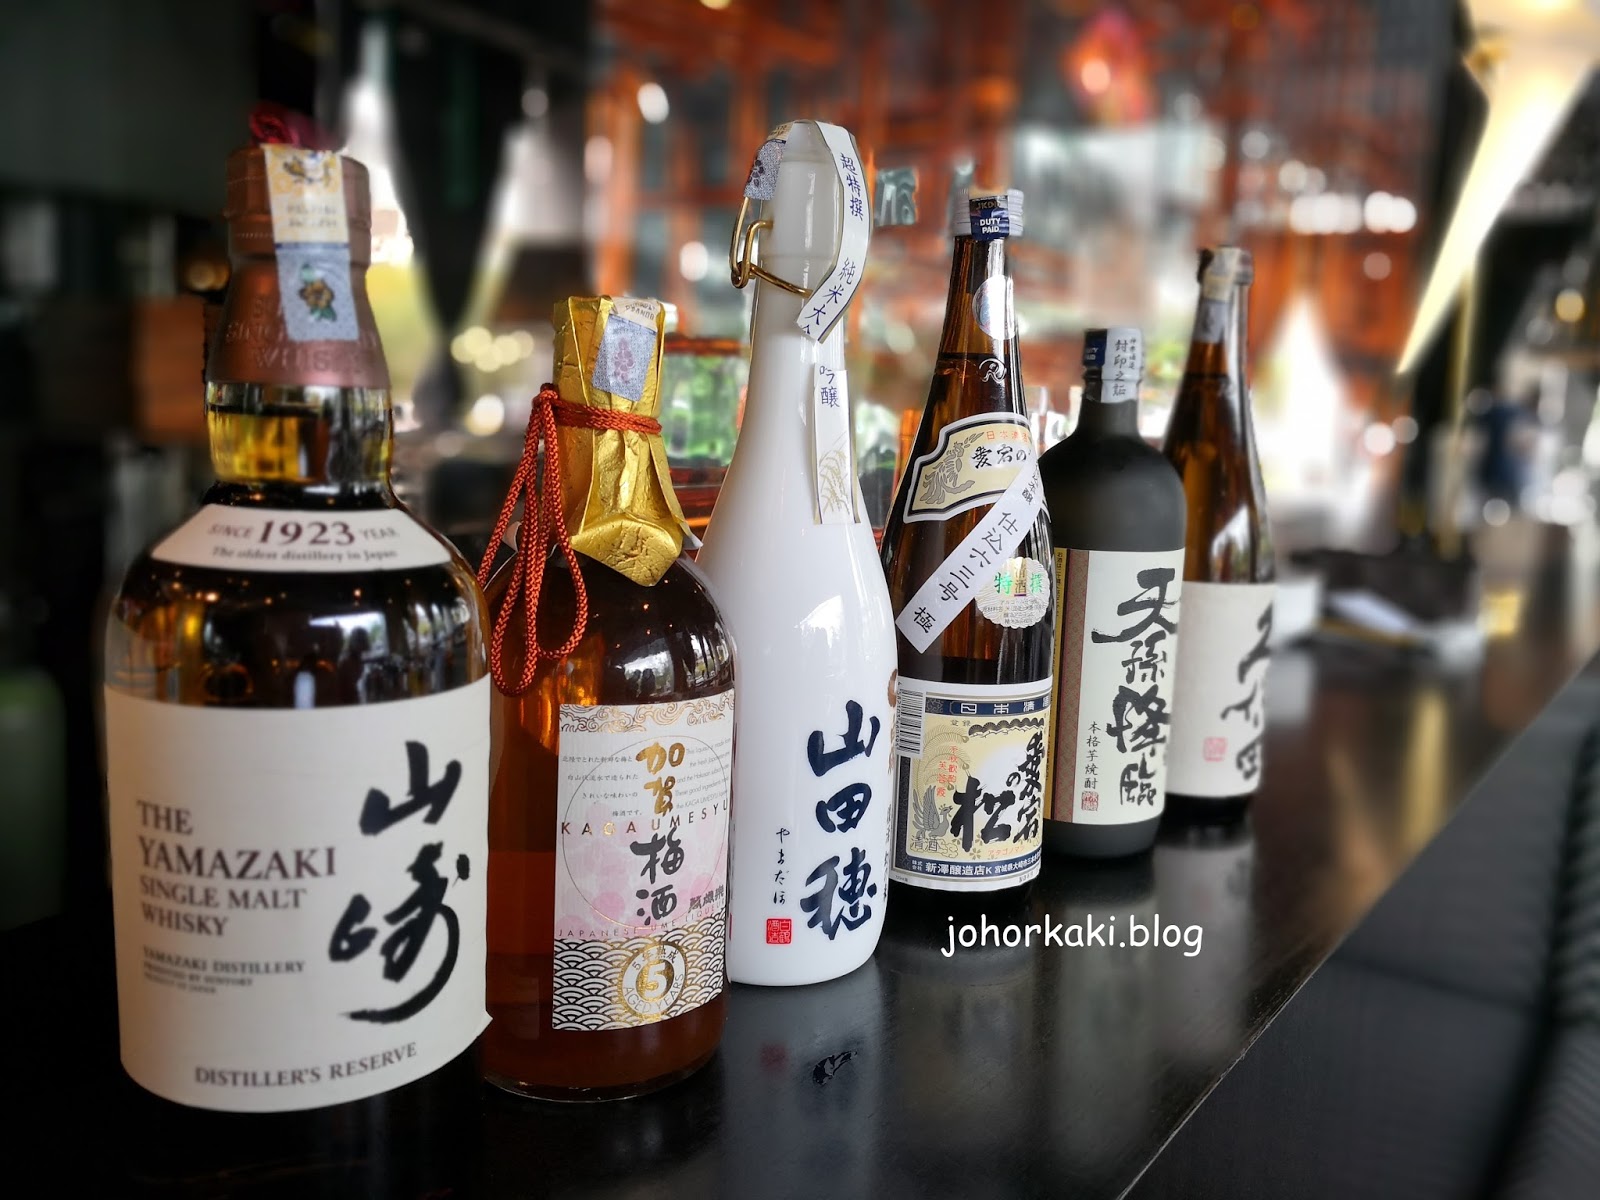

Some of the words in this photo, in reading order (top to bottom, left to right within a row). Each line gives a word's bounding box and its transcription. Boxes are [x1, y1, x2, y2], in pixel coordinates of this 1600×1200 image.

[979, 217, 1001, 227] DUTY
[981, 225, 1000, 235] PAID
[971, 444, 1032, 469] 愛宕の
[206, 523, 255, 539] SINCE
[258, 519, 356, 547] 1923
[359, 527, 398, 541] YEAR
[211, 546, 236, 558] The
[238, 549, 278, 561] oldest
[281, 550, 344, 563] distillery
[364, 550, 398, 563] Japan
[913, 605, 936, 634] 極
[1091, 567, 1179, 807] 天孫降臨
[136, 798, 194, 837] THE
[800, 699, 881, 941] 山田穂
[138, 834, 337, 881] YAMAZAKI
[910, 836, 939, 852] 清酒
[138, 874, 220, 909] SINGLE
[228, 888, 307, 910] MALT
[328, 740, 471, 1025] 山崎
[629, 826, 685, 926] 梅酒
[140, 900, 229, 937] WHISKY
[558, 926, 639, 938] JAPANESE
[650, 919, 676, 931] UME
[142, 944, 208, 973] YAMAZAKI
[212, 959, 306, 975] DISTILLERY
[623, 986, 653, 1014] AGED
[654, 973, 685, 1010] YEARS
[643, 961, 668, 999] 5
[194, 1066, 322, 1088] DISTILLER'S
[329, 1041, 418, 1080] RESERVE
